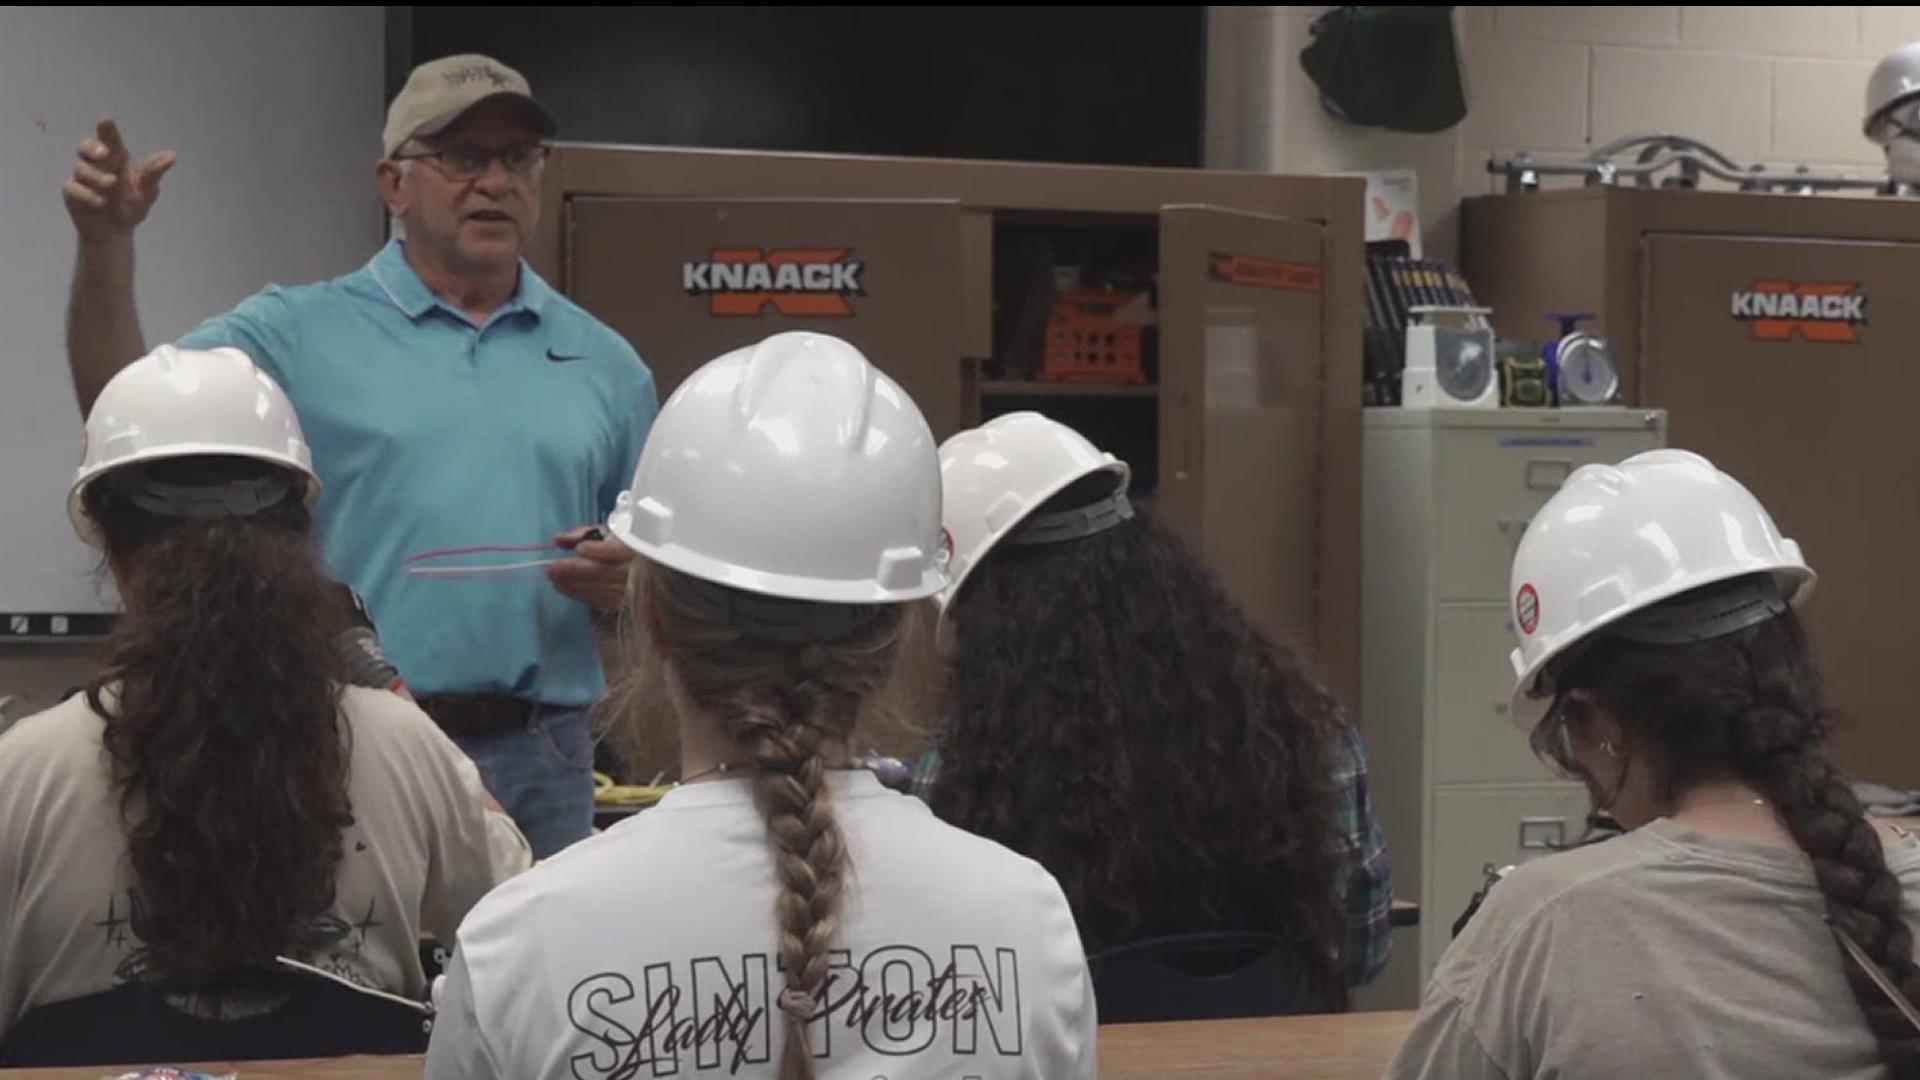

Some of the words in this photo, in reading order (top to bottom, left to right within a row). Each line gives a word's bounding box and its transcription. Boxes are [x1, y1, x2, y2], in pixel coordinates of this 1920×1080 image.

[682, 261, 861, 291] KNAACK
[1731, 291, 1865, 320] KNAACK
[604, 983, 764, 1080] Lady
[777, 962, 991, 1028] Pirates
